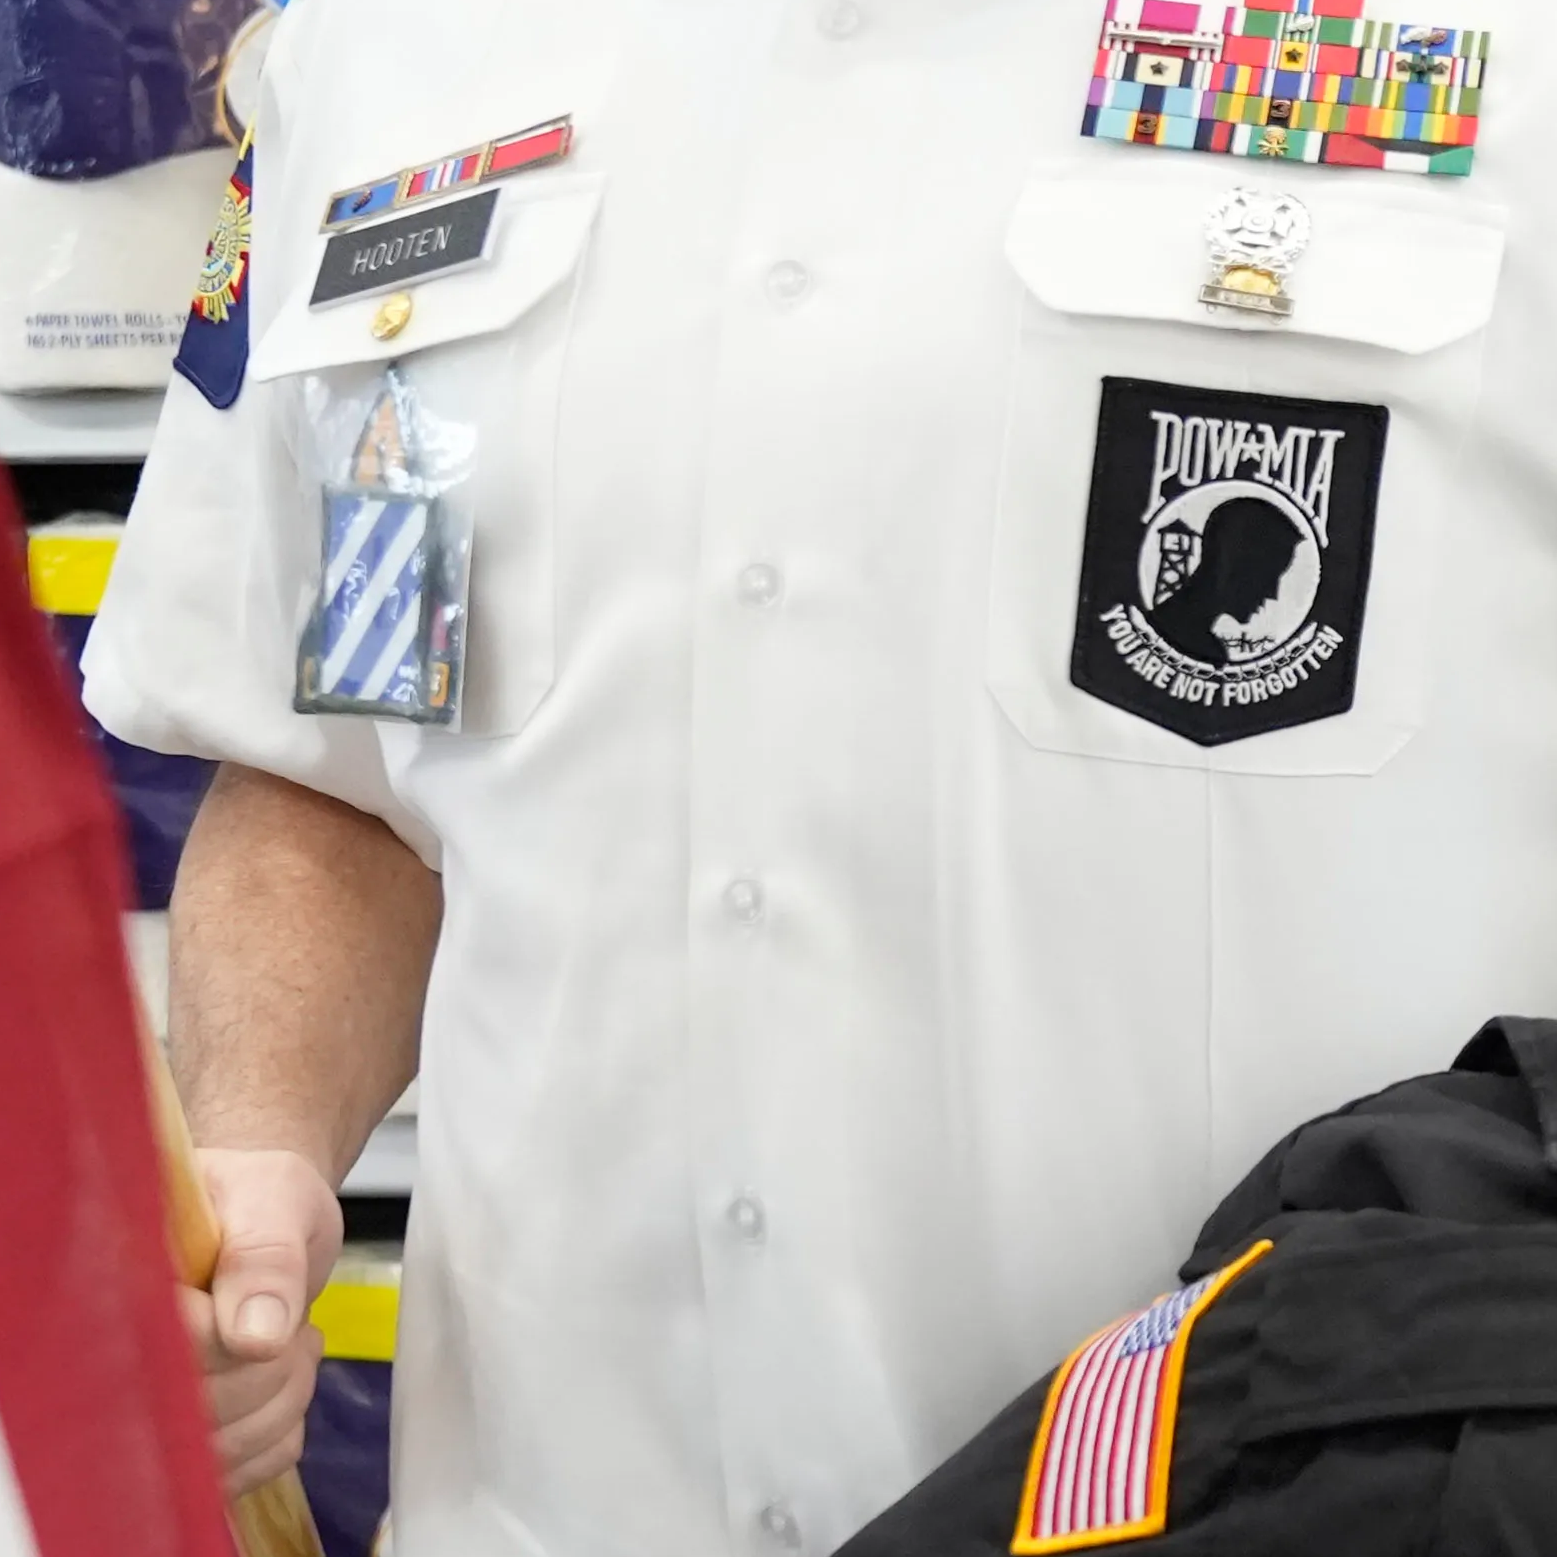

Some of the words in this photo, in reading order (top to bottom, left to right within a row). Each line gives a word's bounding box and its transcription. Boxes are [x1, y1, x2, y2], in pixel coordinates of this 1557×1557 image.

[1269, 97, 1293, 118] 3
[350, 223, 453, 277] HOOTEN
[1099, 602, 1138, 659] YOU
[1127, 648, 1172, 692] ARE
[1169, 679, 1221, 708] NOT
[1222, 624, 1344, 708] FORGOTTEN
